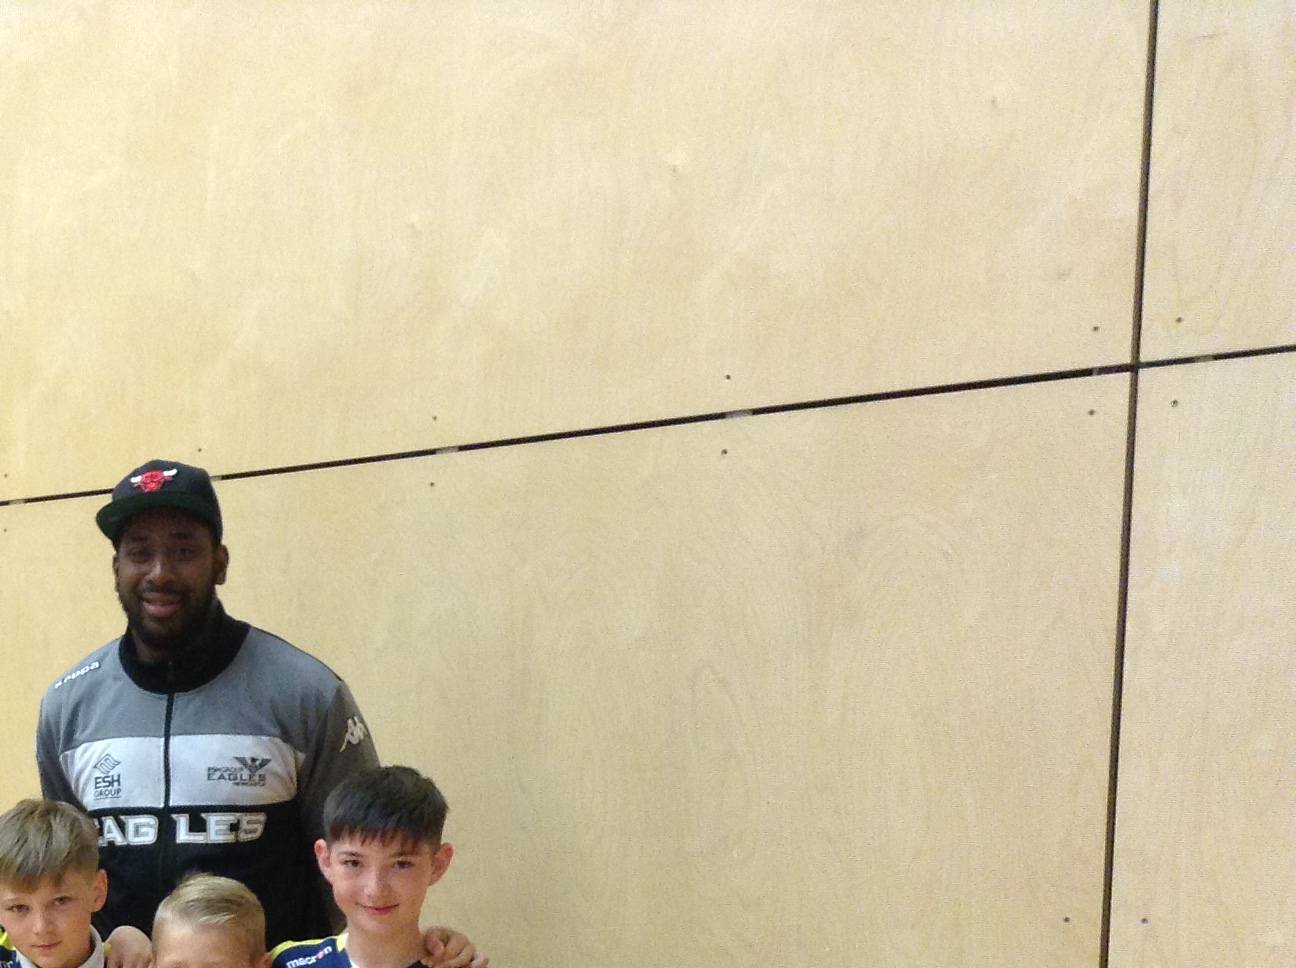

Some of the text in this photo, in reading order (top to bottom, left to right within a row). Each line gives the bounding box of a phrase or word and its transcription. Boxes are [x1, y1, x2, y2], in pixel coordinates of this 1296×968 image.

[94, 774, 121, 789] ESH
[207, 773, 267, 781] EAGLES
[94, 788, 122, 797] GROUP
